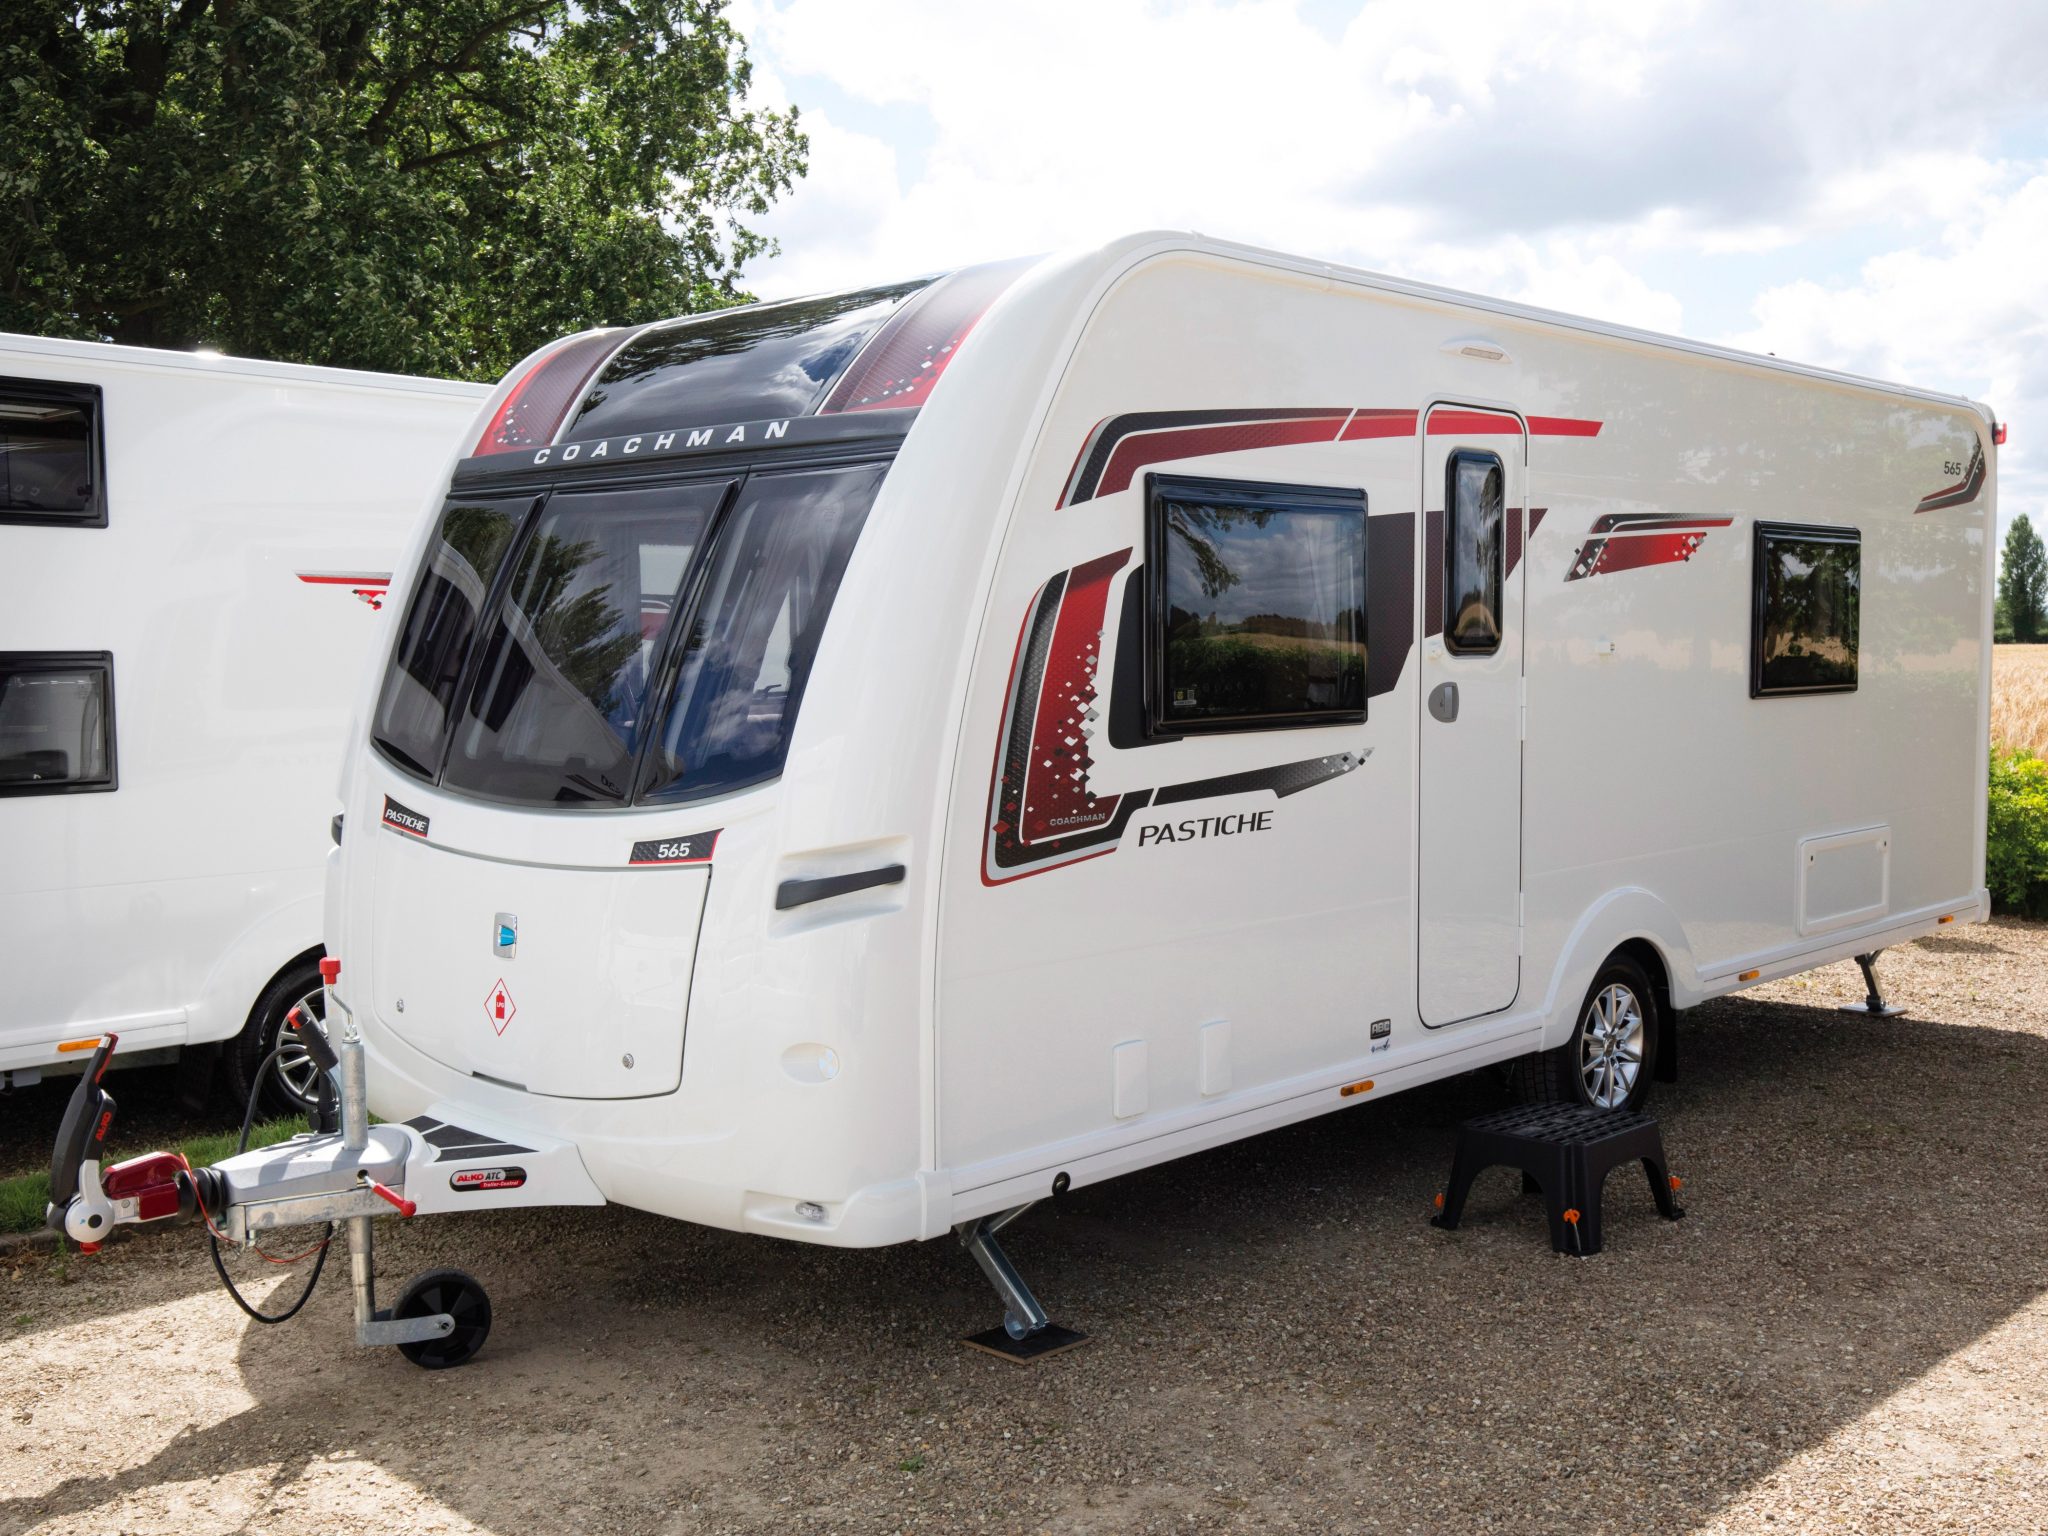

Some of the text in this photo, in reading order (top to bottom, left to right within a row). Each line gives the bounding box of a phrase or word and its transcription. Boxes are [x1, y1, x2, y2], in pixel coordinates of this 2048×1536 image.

[533, 420, 790, 465] COACHMAN
[1943, 461, 1962, 475] 565
[384, 808, 427, 832] PASTICHE
[1049, 812, 1106, 826] COACHMAN
[1137, 809, 1275, 847] PASTICHE
[657, 842, 691, 858] 565
[485, 1171, 501, 1180] ATC
